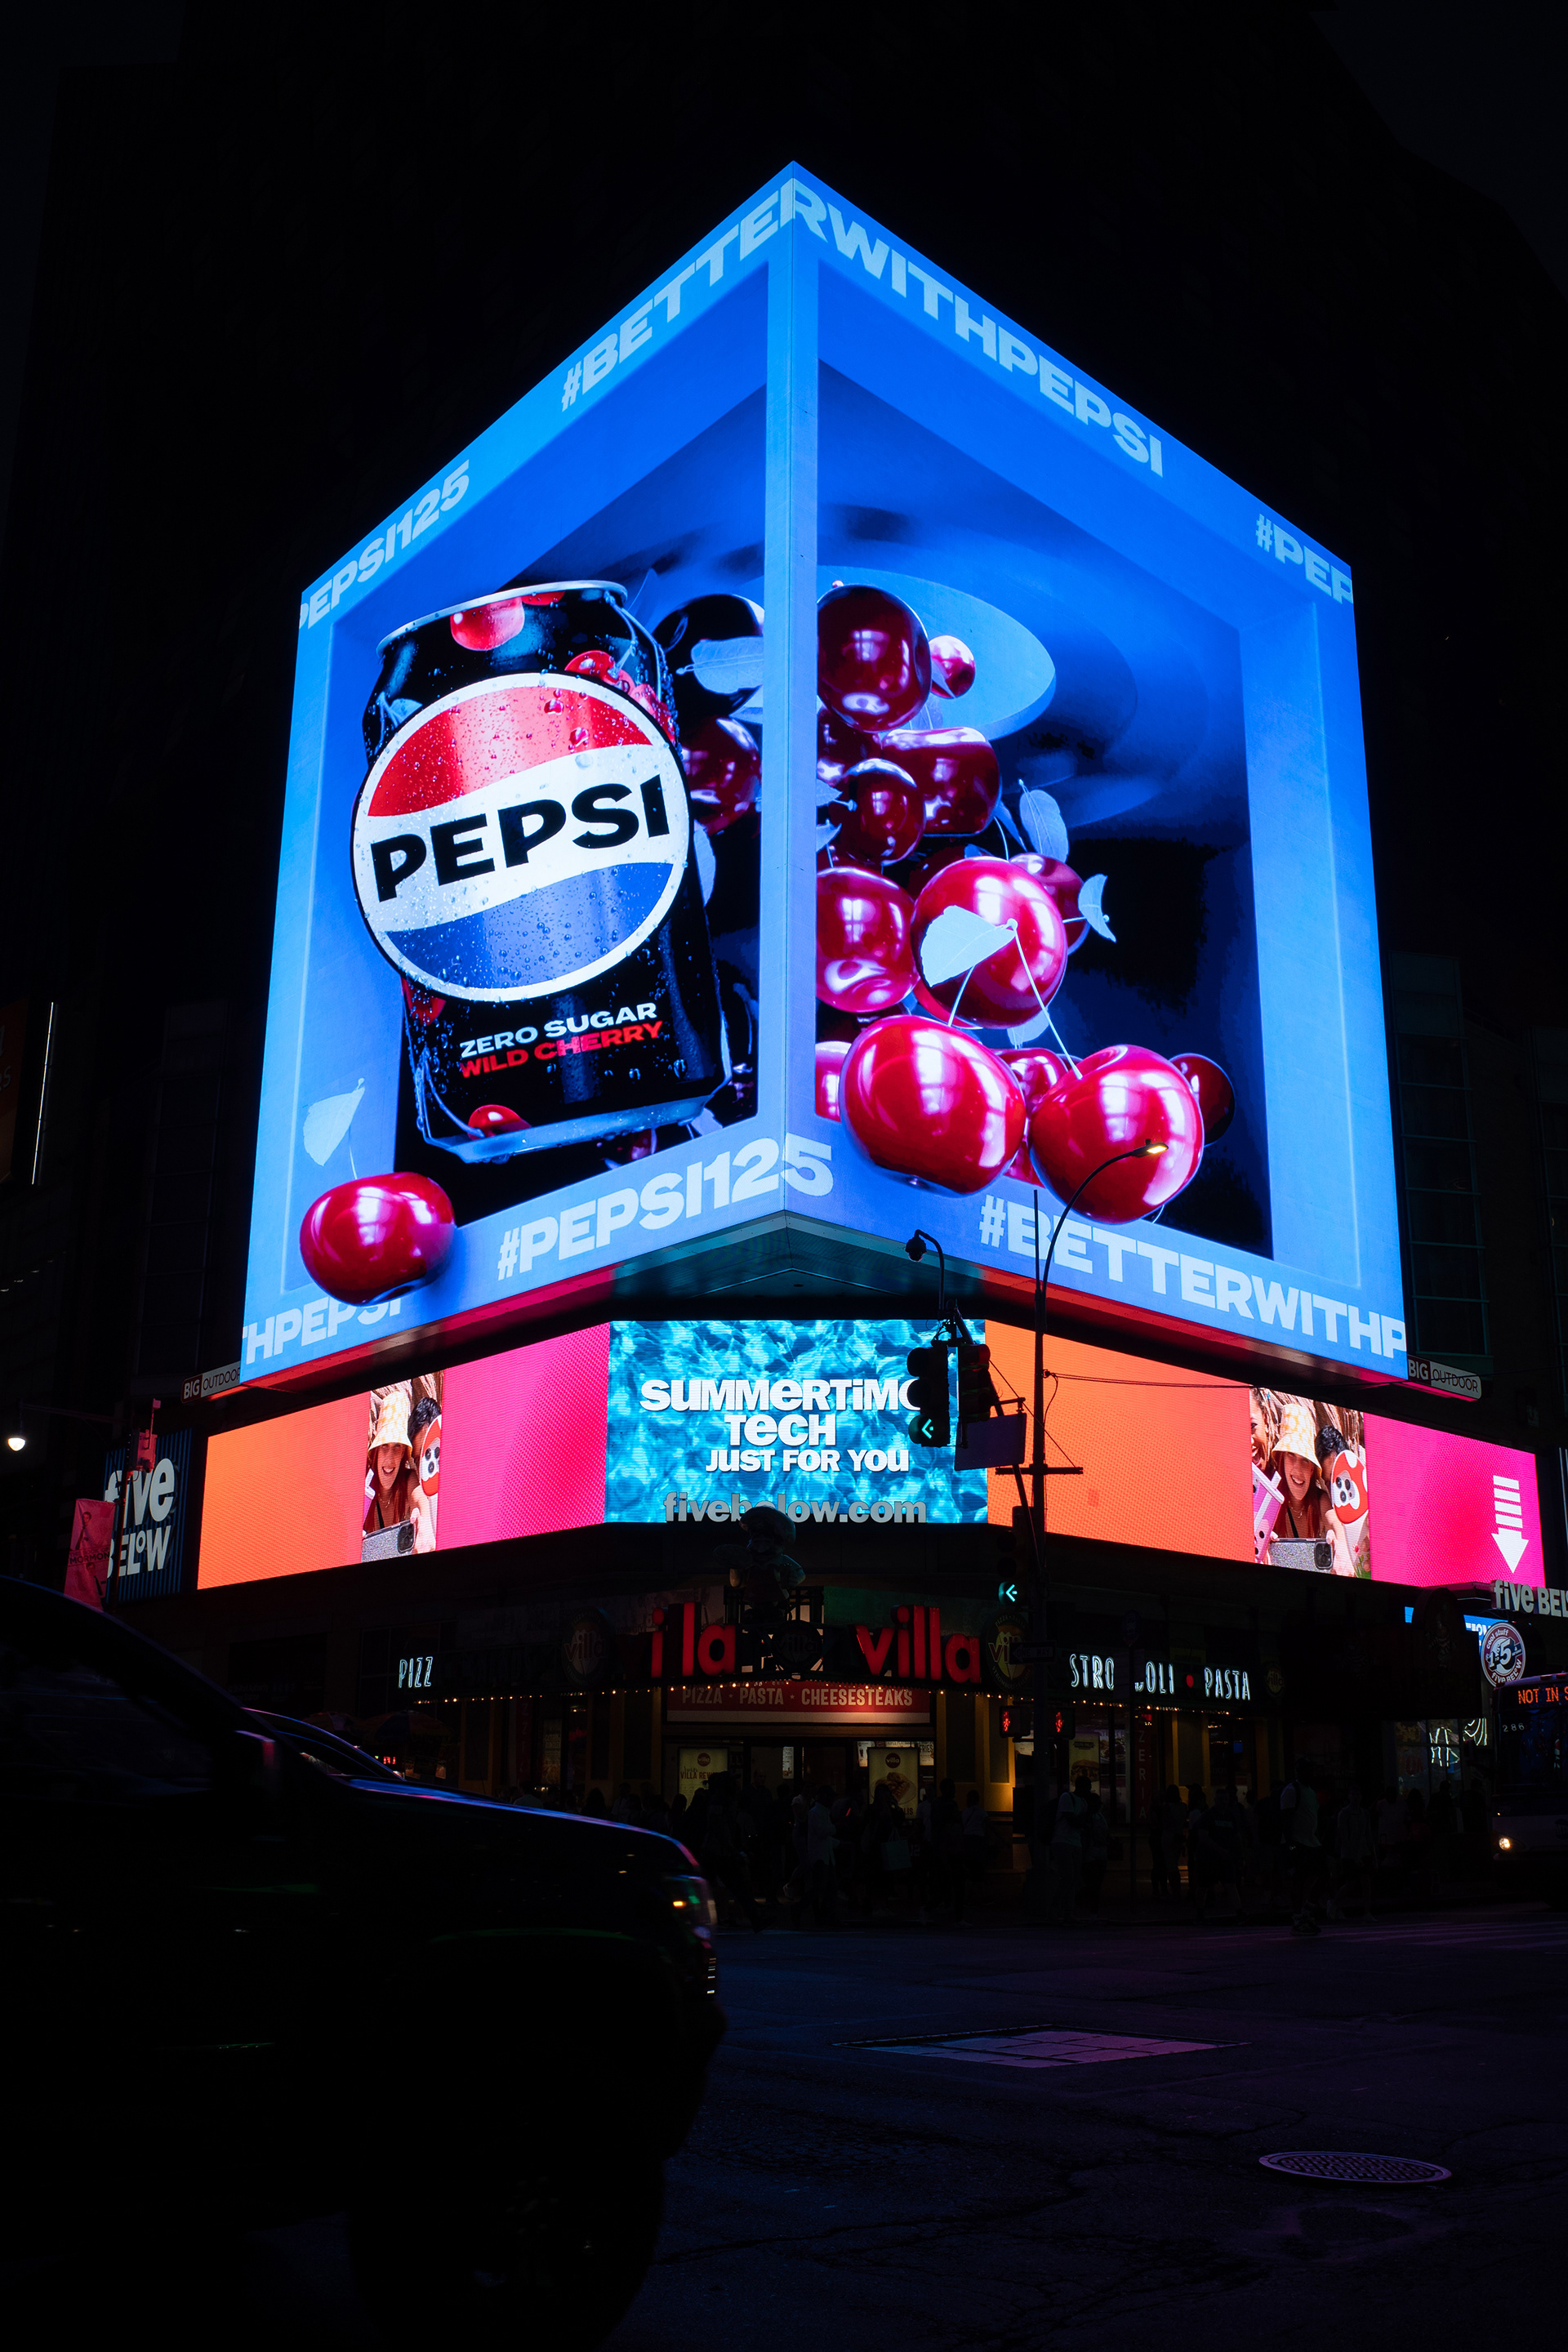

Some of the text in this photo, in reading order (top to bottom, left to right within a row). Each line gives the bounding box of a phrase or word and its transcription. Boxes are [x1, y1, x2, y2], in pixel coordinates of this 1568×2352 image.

[562, 177, 1163, 477] #BETTERWITHPEPSI
[1255, 514, 1354, 604] #PEP
[370, 774, 670, 902] PEPSI
[460, 1002, 657, 1058] ZERO SUGAR
[461, 1020, 663, 1079] WILD CHERRY
[497, 1133, 834, 1281] #PEPSI125
[979, 1194, 1406, 1359] #BETTERWITHP
[184, 1379, 201, 1399] BIG
[1407, 1359, 1478, 1393] BIG OUTDOOR
[783, 1449, 840, 1472] FOR
[69, 1552, 109, 1565] MORMON
[1494, 1579, 1568, 1618] five BEL
[564, 1633, 606, 1662] villa
[853, 1605, 980, 1683] villa
[1017, 1648, 1051, 1658] ONE WAY
[682, 1686, 913, 1707] PIZZA PASTA CHEESESTEAKS
[1069, 1653, 1175, 1695] STROOLI
[1204, 1666, 1250, 1701] PASTA
[1517, 1688, 1539, 1704] NOT
[1545, 1686, 1559, 1703] IN
[680, 1771, 697, 1779] VILLA
[1138, 1718, 1147, 1820] ZERIA
